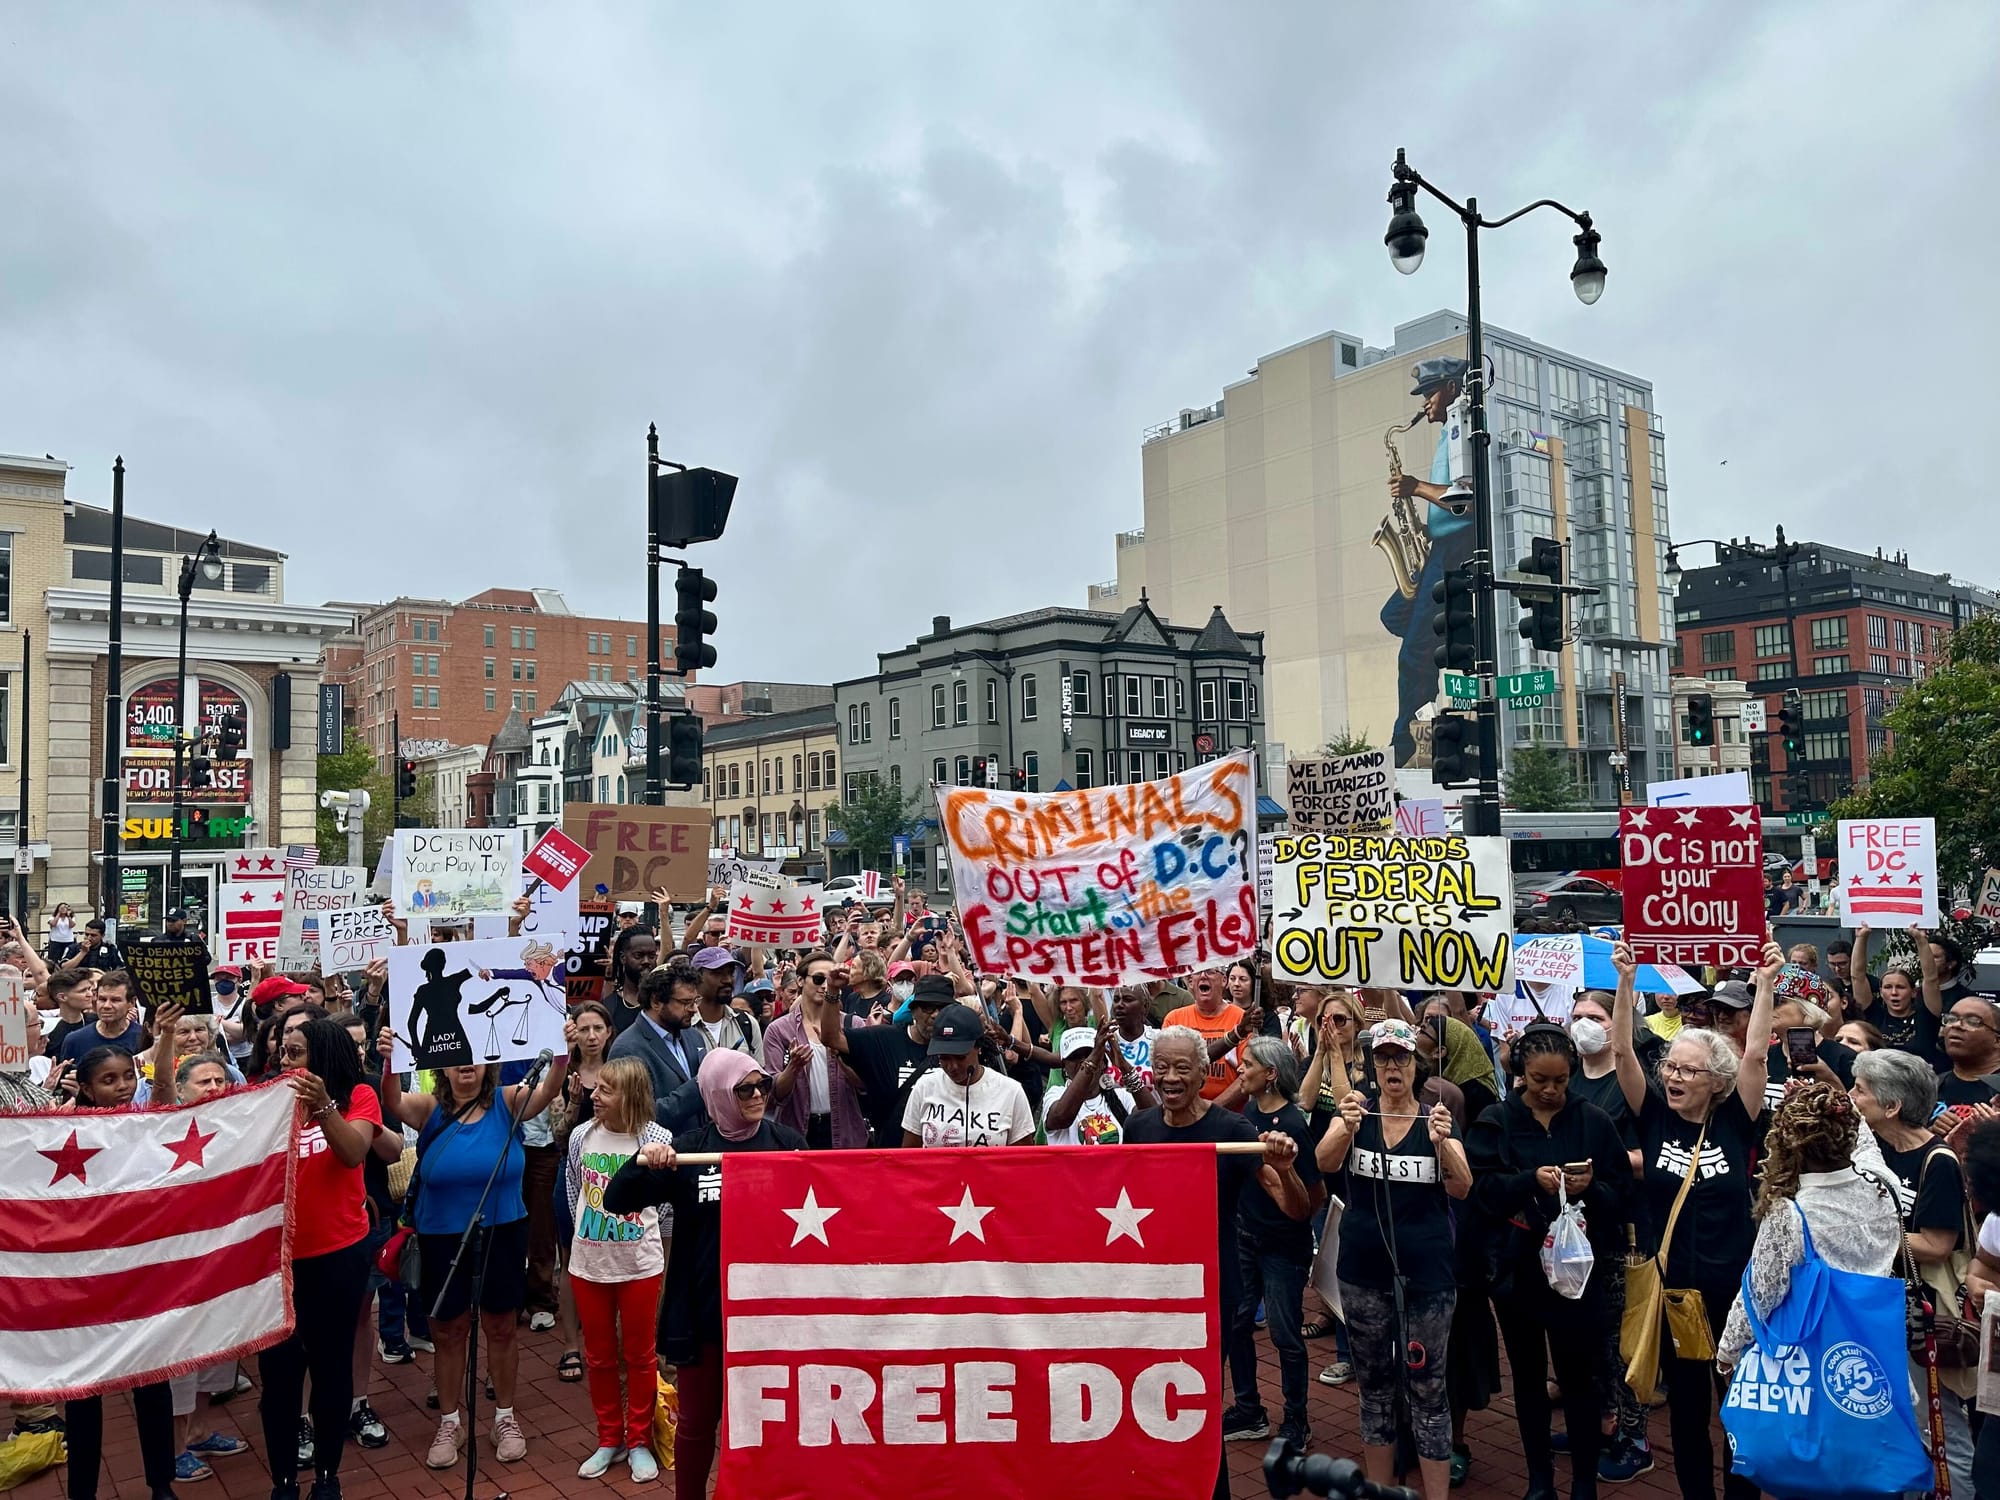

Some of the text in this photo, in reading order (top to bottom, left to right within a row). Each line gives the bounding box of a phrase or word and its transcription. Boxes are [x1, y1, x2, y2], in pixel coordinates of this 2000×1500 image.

[1450, 678, 1475, 695] 14 ST
[1509, 675, 1545, 694] U ST
[1534, 683, 1546, 691] NW
[1061, 676, 1072, 735] LEGACY DC
[1453, 699, 1471, 710] 2000
[1509, 696, 1542, 709] 1400
[149, 726, 161, 734] 14
[1130, 728, 1168, 740] LEGACY DC
[1289, 752, 1384, 779] WE DEMAND
[125, 769, 246, 789] FOR ASE
[1288, 771, 1386, 795] MILITARIZED
[1292, 788, 1389, 810] FORCES OUT
[1295, 801, 1392, 826] OF DC NOW!
[1801, 813, 1813, 825] U
[119, 816, 254, 840] SUBAY
[585, 810, 690, 853] FREE
[1291, 824, 1321, 834] THERE
[1323, 827, 1333, 835] IS
[1335, 827, 1349, 835] NO
[1512, 831, 1542, 839] metrobus
[1848, 825, 1922, 849] FREE
[413, 834, 505, 853] DC is NOT
[1274, 833, 1470, 864] DC DEMANDS
[1623, 832, 1759, 867] DC is not
[406, 854, 508, 877] Your Play Toy
[536, 850, 572, 877] FREE DC
[1867, 850, 1907, 871] DC
[121, 867, 148, 877] Open
[291, 869, 330, 889] RISE
[612, 855, 672, 893] DC
[987, 865, 1080, 903] OUT
[1296, 860, 1501, 910] FEDERAL
[1661, 868, 1718, 898] your
[293, 889, 357, 911] RESIST!
[580, 903, 609, 911] ism.org
[1132, 880, 1193, 916] the
[1328, 903, 1452, 928] FORCES
[1642, 894, 1738, 933] Colony
[331, 924, 393, 943] FORCES
[728, 926, 820, 944] FREE DC
[127, 946, 202, 957] DC DEMANDS
[229, 941, 277, 962] FRE
[332, 942, 380, 966] OUT
[1529, 939, 1574, 951] NEED
[1629, 943, 1760, 966] FREE DC
[127, 956, 194, 968] FEDERAL
[1276, 926, 1510, 990] OUT NOW
[1518, 948, 1576, 963] MILITARY
[135, 968, 194, 980] FORCES
[1533, 968, 1571, 980] OATH
[1541, 960, 1578, 972] KEEPS
[140, 981, 184, 994] OUT
[432, 1031, 456, 1043] LADY
[428, 1041, 462, 1054] JUSTICE
[926, 1102, 1001, 1132] MAKE
[1357, 1154, 1434, 1181] ESIST.
[1655, 1155, 1730, 1180] FRE DC
[698, 1187, 721, 1203] FR
[1828, 1351, 1842, 1370] cool
[727, 1359, 1208, 1450] FREE DC
